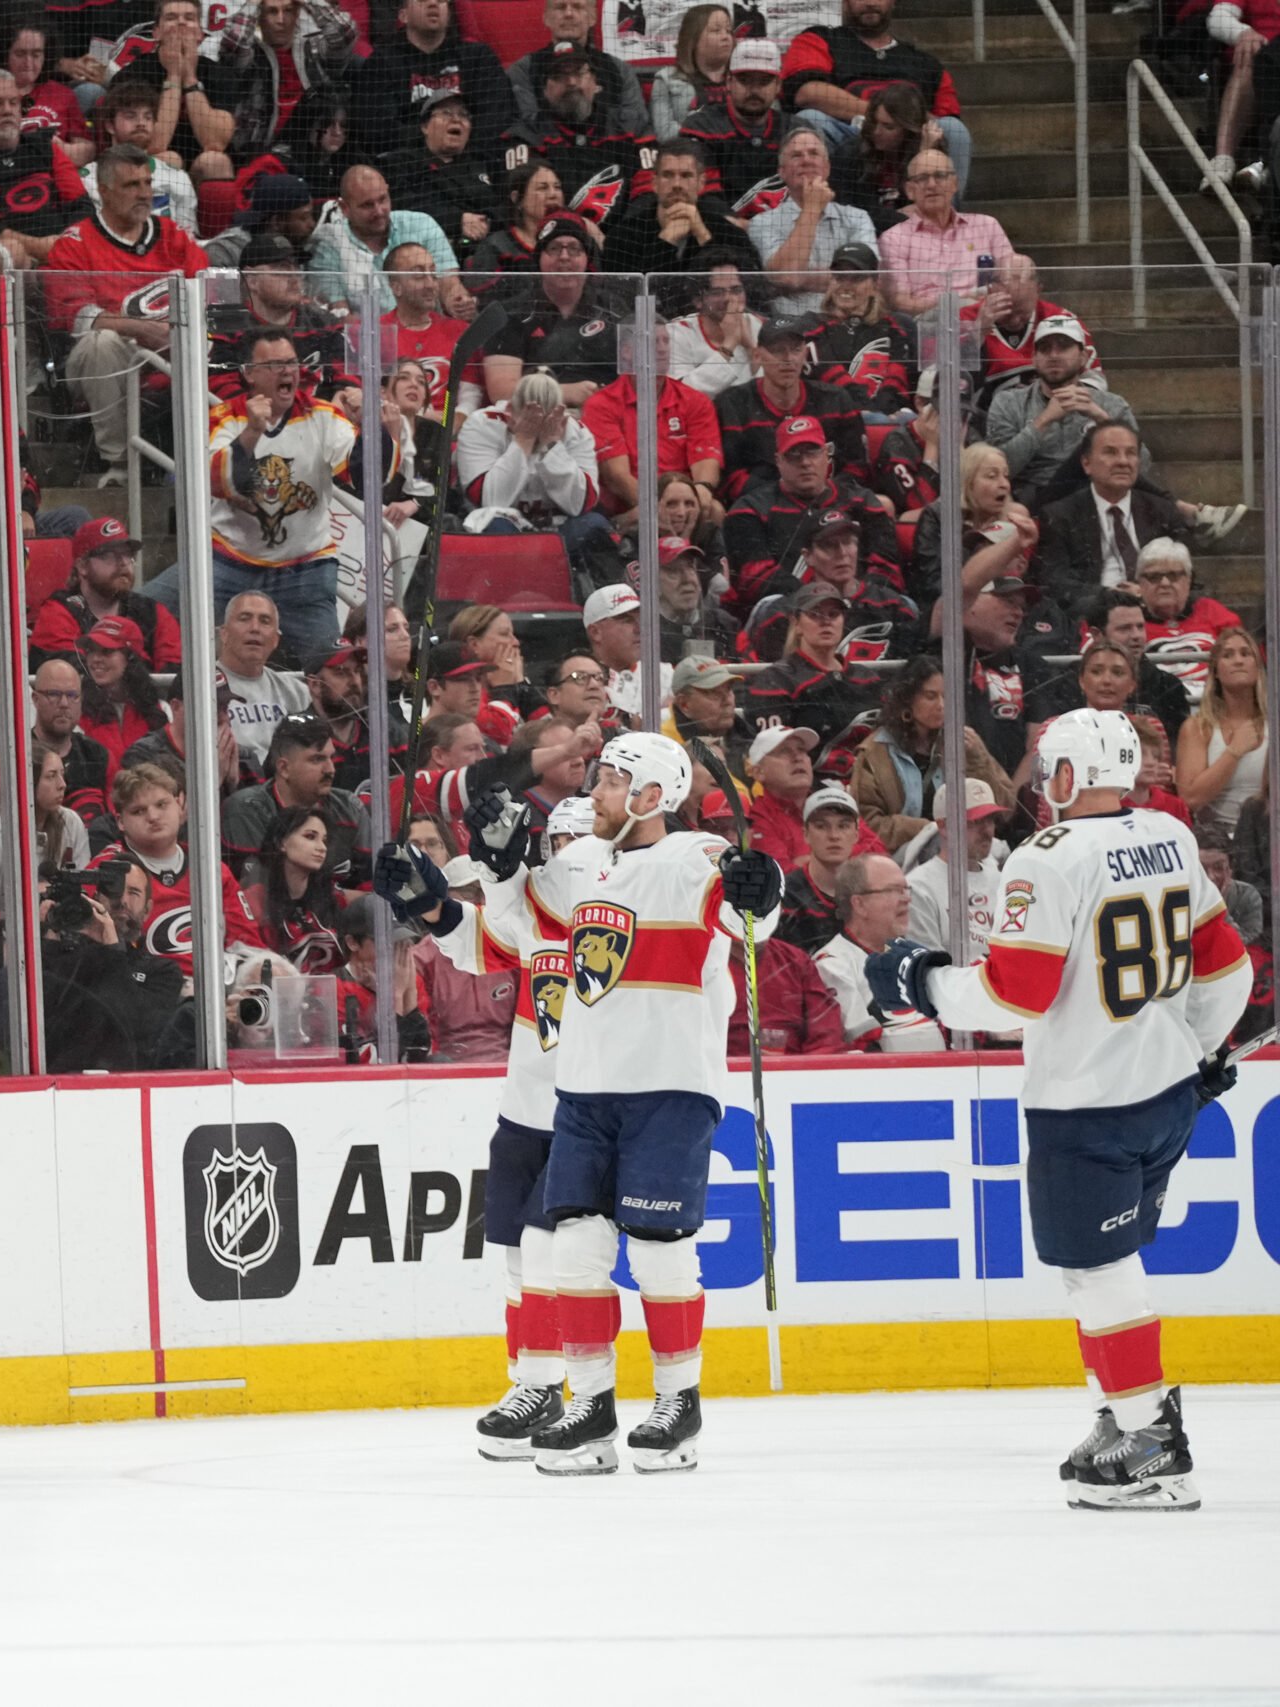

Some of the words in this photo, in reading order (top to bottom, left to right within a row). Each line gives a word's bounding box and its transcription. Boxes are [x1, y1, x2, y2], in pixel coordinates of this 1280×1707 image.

[208, 3, 228, 32] C
[668, 416, 681, 431] S
[894, 463, 915, 488] 3
[1119, 747, 1134, 765] 88
[1106, 840, 1184, 883] SCHMIDT
[573, 908, 626, 929] FLORIDA
[1093, 884, 1192, 1023] 88
[220, 1180, 264, 1247] NHL
[621, 1195, 682, 1212] BAUER
[1136, 1451, 1172, 1480] CCM
